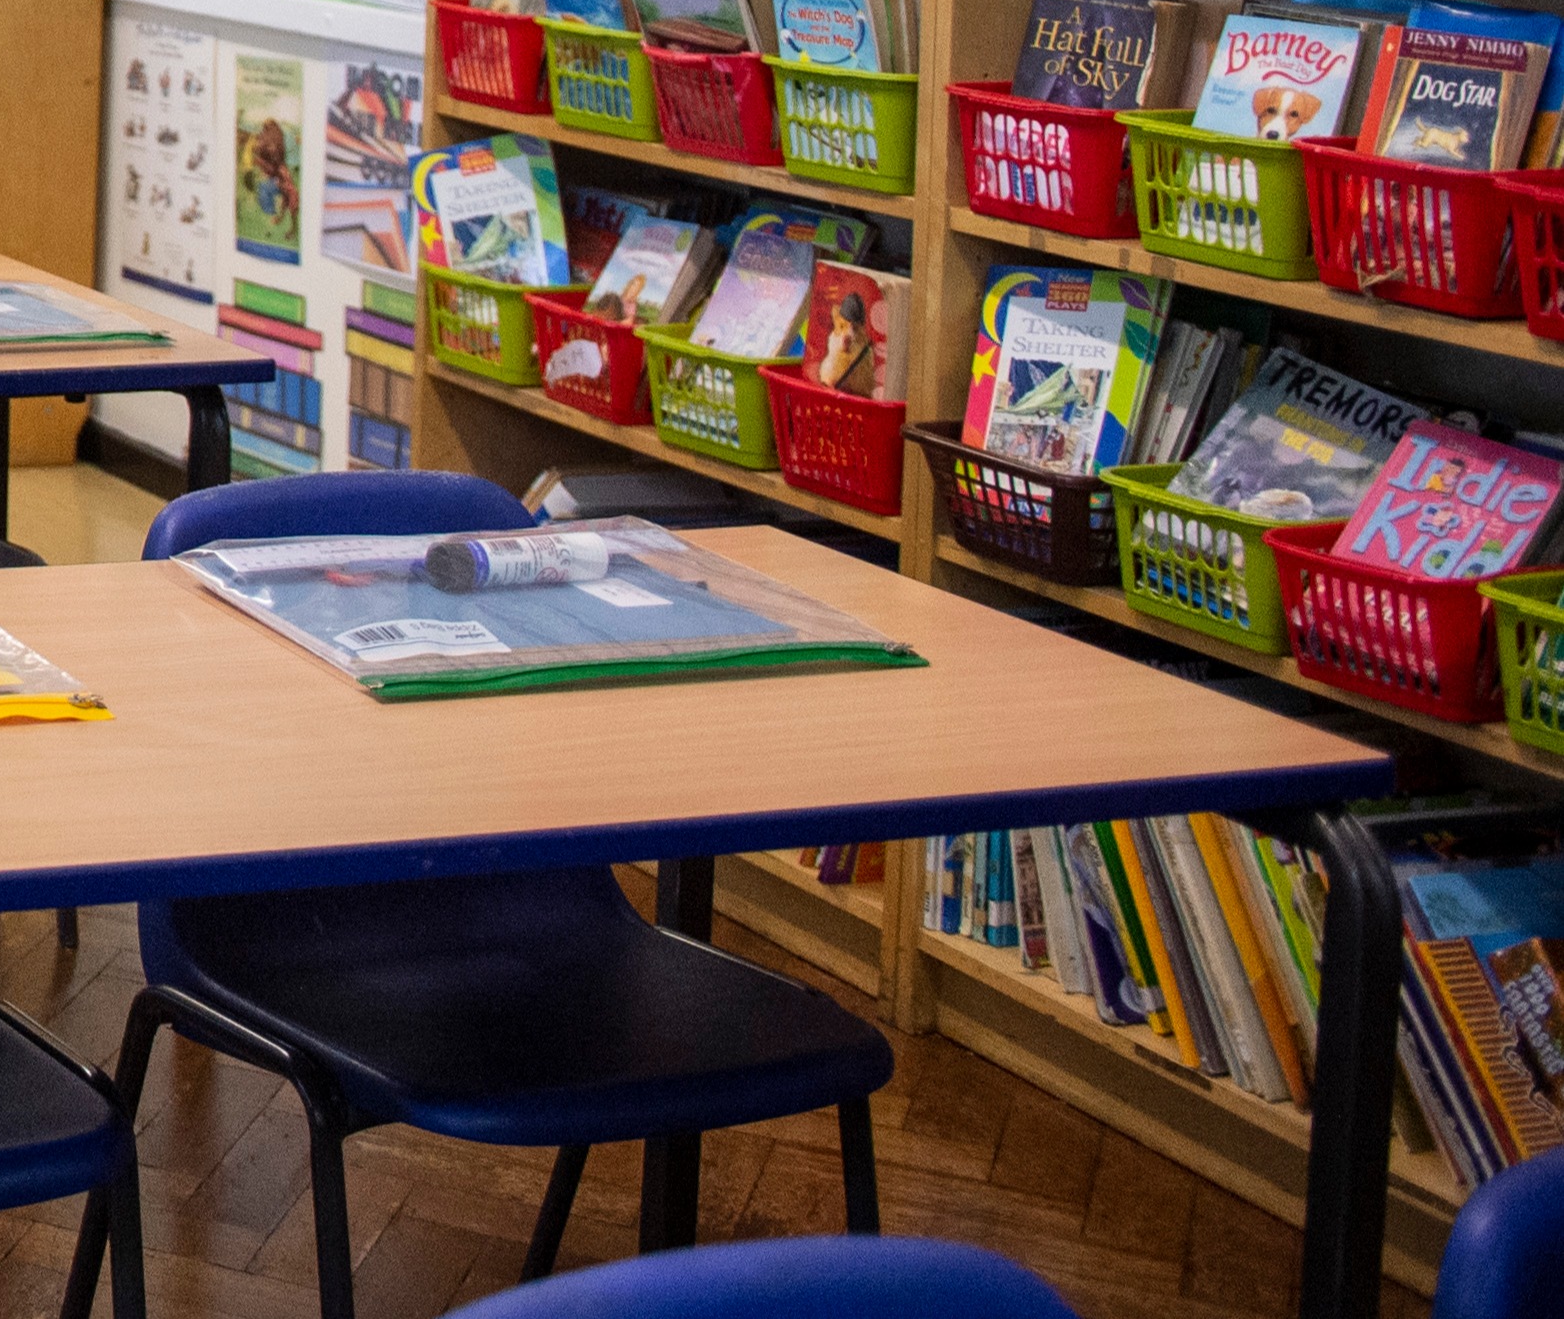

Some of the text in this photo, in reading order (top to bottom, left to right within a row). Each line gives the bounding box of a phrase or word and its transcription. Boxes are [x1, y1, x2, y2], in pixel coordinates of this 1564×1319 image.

[797, 7, 854, 29] Witch's Dog
[1066, 6, 1081, 24] A
[792, 28, 854, 49] Treasure Map
[1031, 18, 1144, 67] Hat Full
[1405, 32, 1524, 57] JENNY NIMMO
[1045, 54, 1074, 75] of
[1225, 31, 1347, 84] Barney
[1412, 75, 1496, 107] DOG STAR
[1047, 301, 1087, 311] PLAYS
[1023, 317, 1105, 338] TAKING
[1012, 336, 1107, 358] SHELTER
[1270, 356, 1419, 443] TREMORS
[1351, 490, 1531, 578] Kidd
